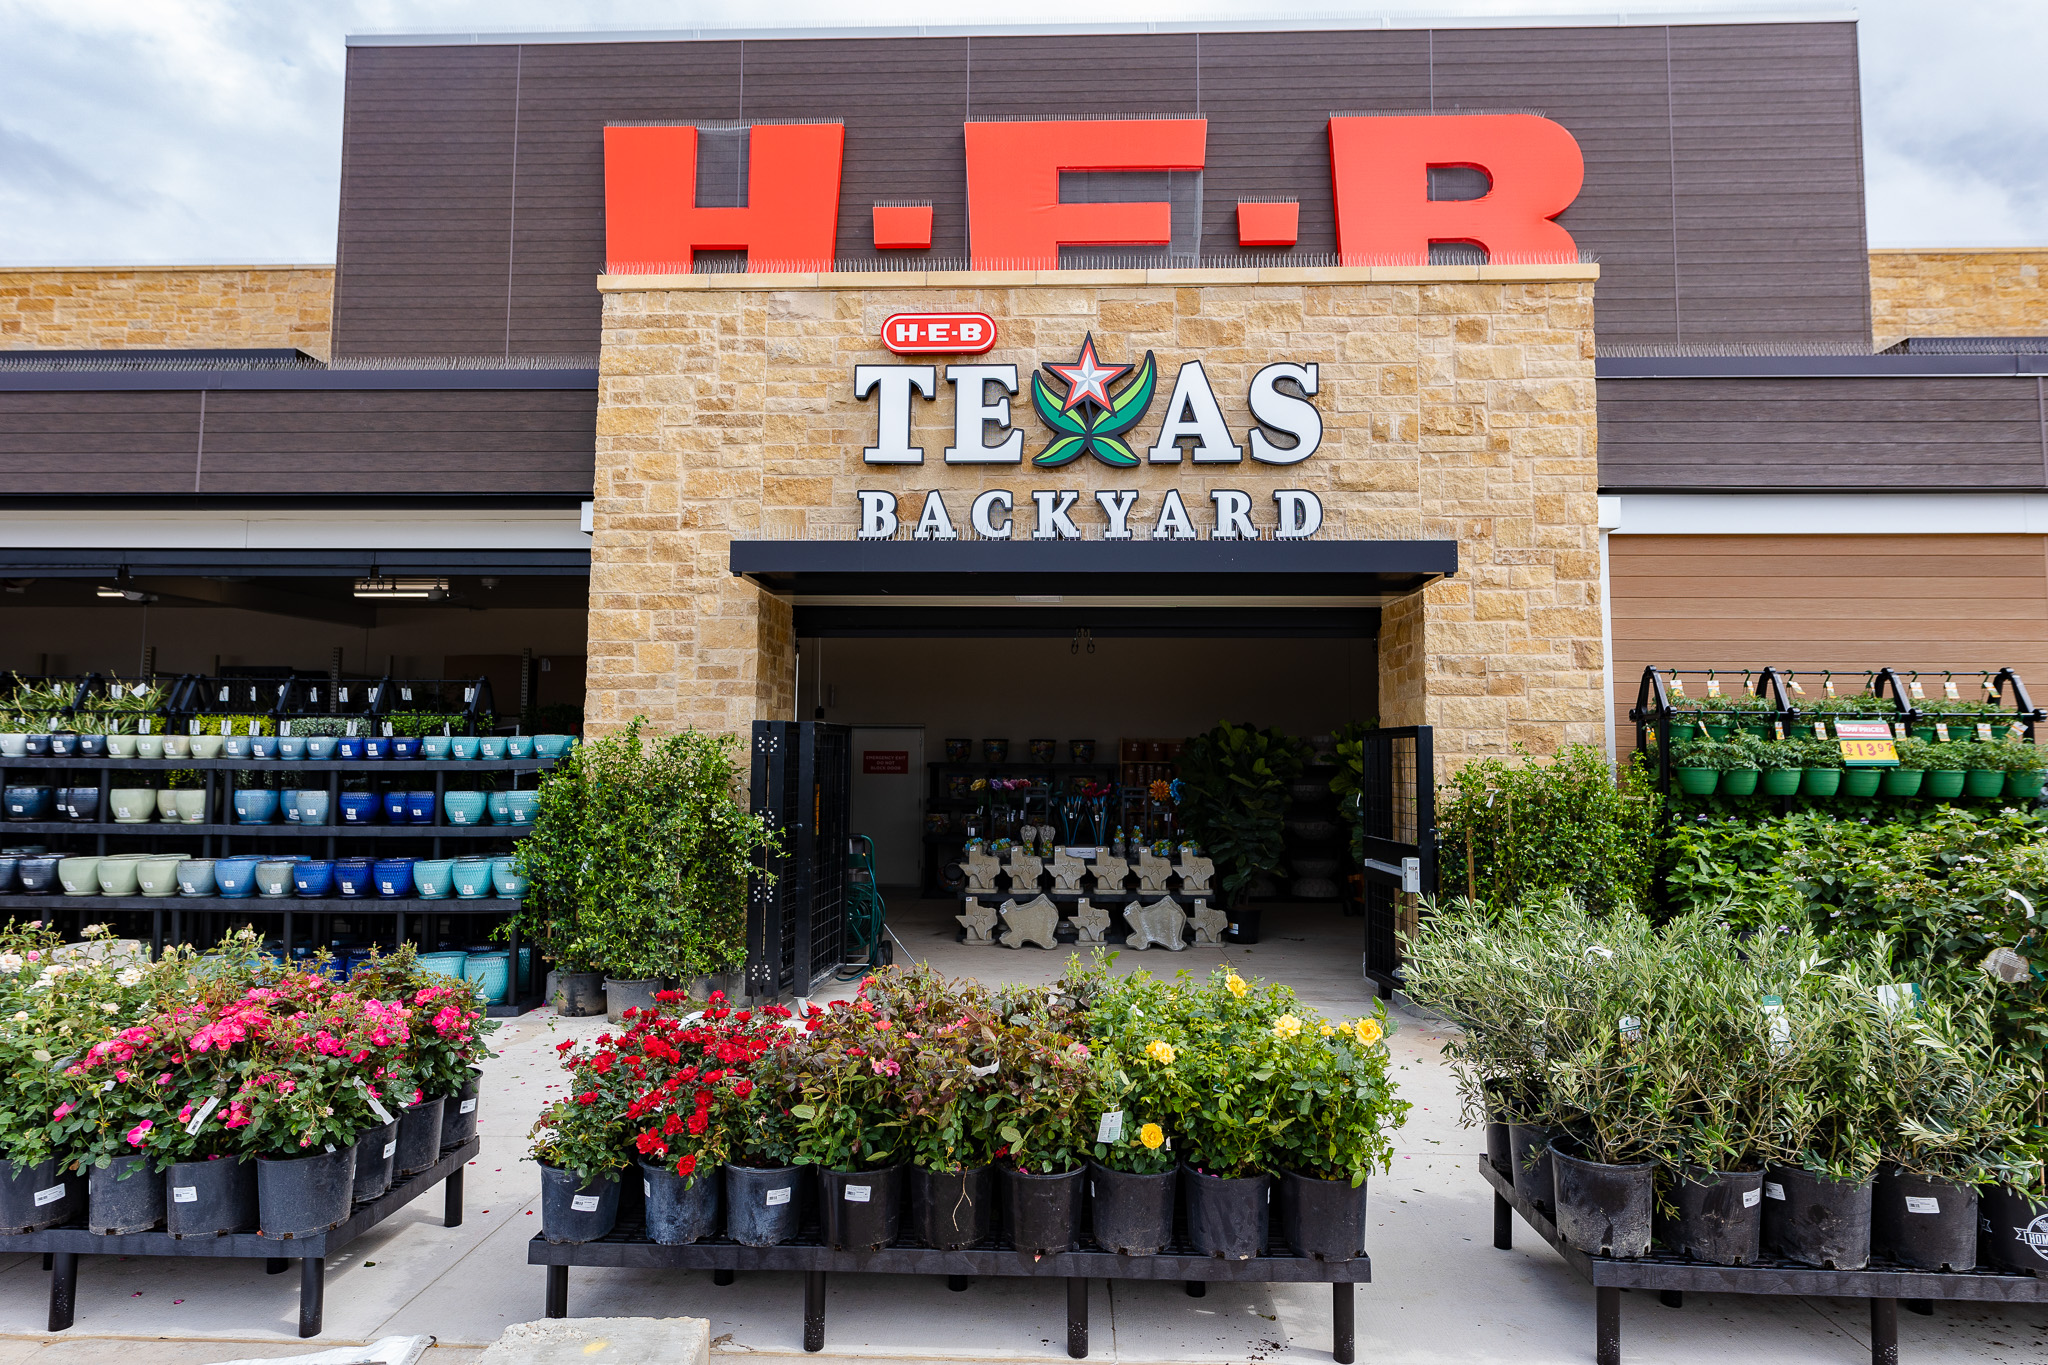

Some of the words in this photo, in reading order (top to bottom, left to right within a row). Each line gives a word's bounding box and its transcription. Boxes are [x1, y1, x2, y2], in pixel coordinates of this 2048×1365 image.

[602, 112, 1585, 272] H-E-B
[895, 322, 983, 342] H-E-B
[854, 332, 1324, 468] TEXAS
[856, 487, 1325, 541] BACKYARD
